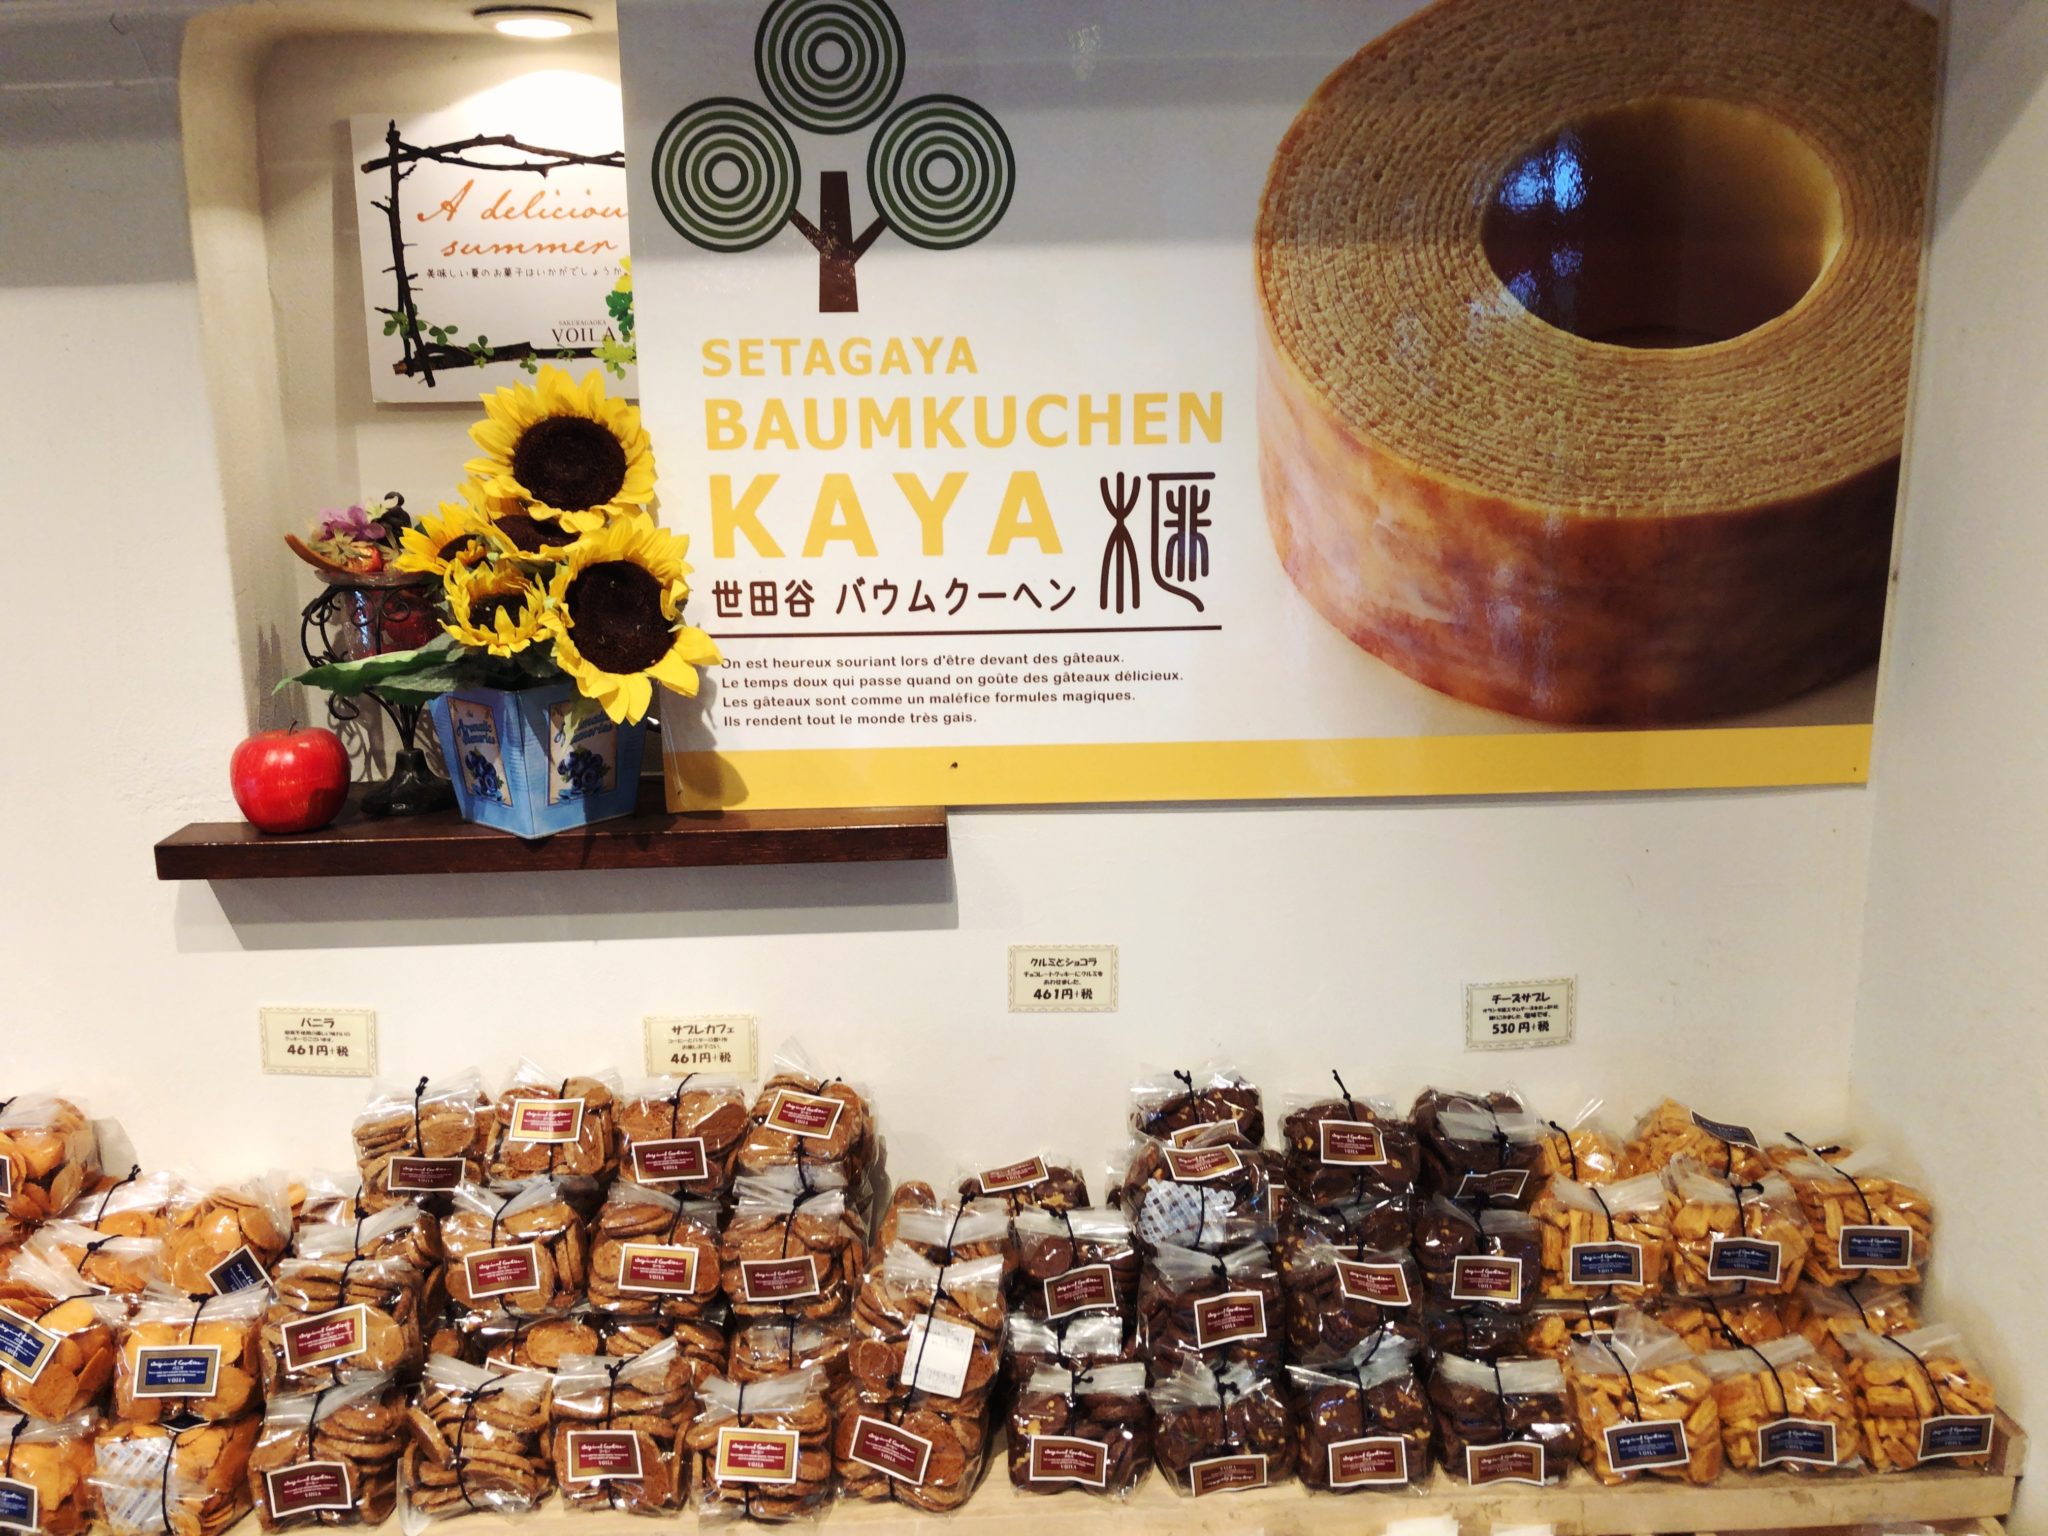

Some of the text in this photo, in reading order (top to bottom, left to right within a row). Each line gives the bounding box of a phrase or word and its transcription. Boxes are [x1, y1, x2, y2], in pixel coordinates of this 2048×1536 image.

[417, 179, 628, 222] A deliciou
[442, 240, 617, 257] summer
[551, 326, 616, 343] VOILA
[702, 336, 978, 378] SETAGAYA
[704, 391, 1223, 451] BAUMKUCHEN
[708, 470, 1063, 559] KAYA
[711, 576, 1076, 618] 世田谷 バウムクーヘン
[720, 652, 1124, 670] On est heureux souriant lors d'être devant des gâteaux.
[721, 670, 1184, 691] Le temps doux qui passe quand on goûte des gâteaux délicieux.
[722, 690, 1136, 710] Les gâteaux sont comme un maléfice formules magiques.
[723, 711, 977, 727] Ils rendent tout le monde très gais.
[1030, 957, 1097, 968] クルミとショコラ
[300, 1017, 335, 1029] バニラ
